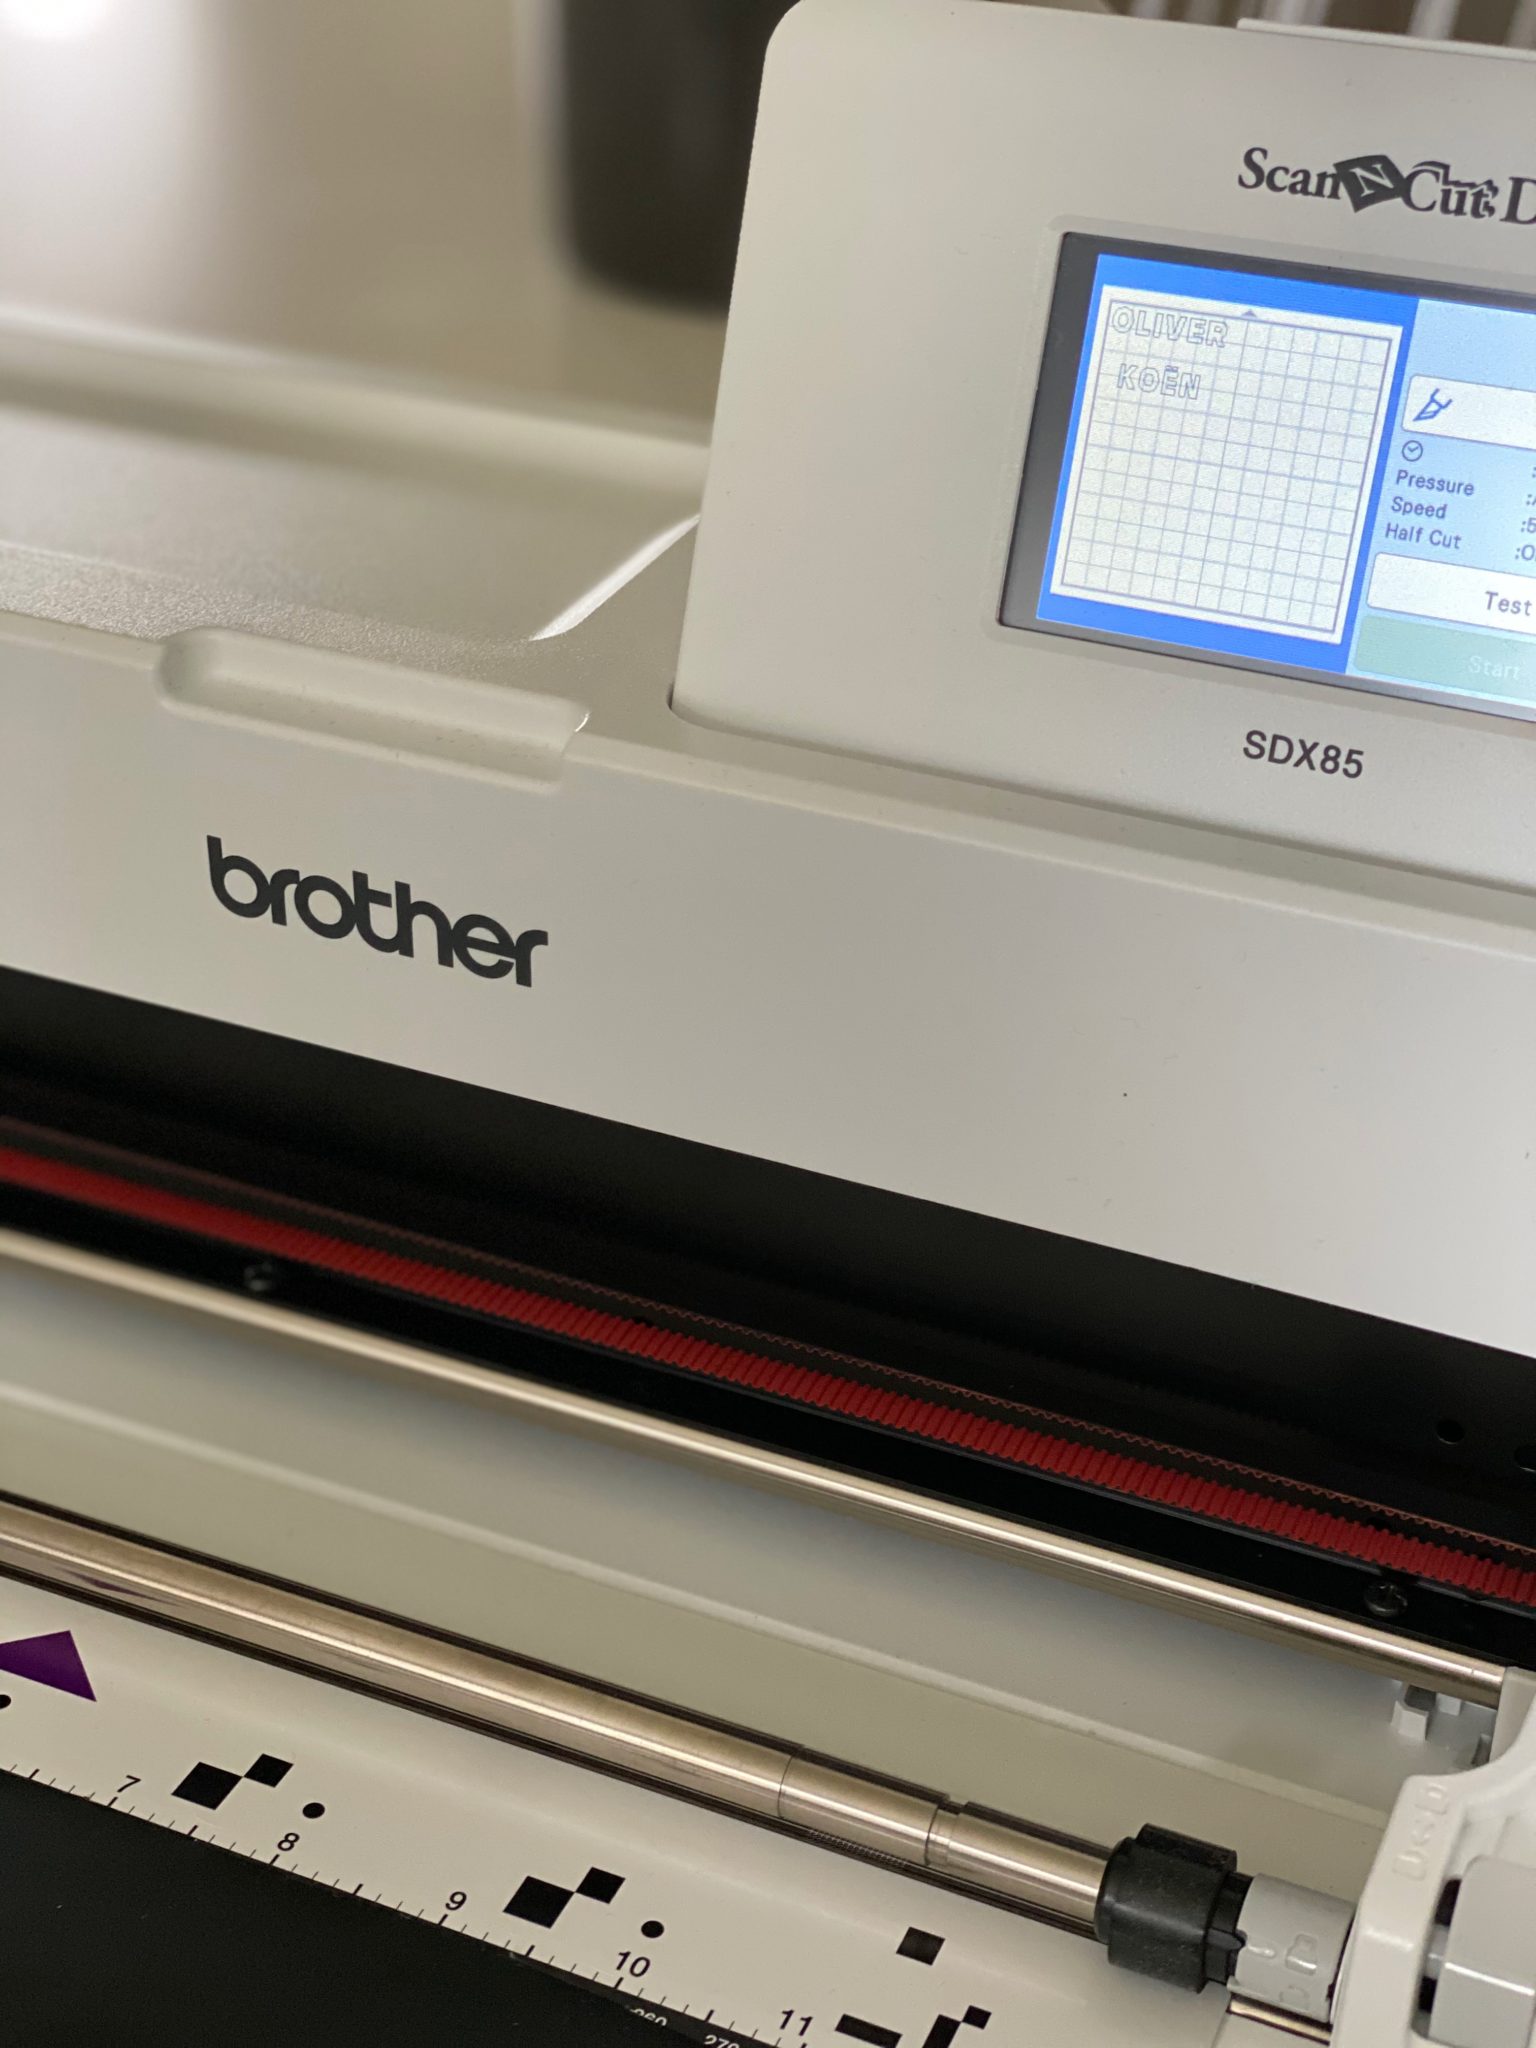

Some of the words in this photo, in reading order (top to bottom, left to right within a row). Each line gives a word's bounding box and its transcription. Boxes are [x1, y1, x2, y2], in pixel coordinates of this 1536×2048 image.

[1111, 305, 1229, 348] OLIVER
[1395, 469, 1475, 496] Pressure
[1391, 496, 1448, 519] Speed
[1385, 522, 1424, 543] Half
[1429, 529, 1462, 549] Cut
[1485, 590, 1533, 617] Test
[1468, 655, 1521, 681] Start
[1243, 729, 1365, 779] SDX85
[206, 834, 549, 988] brother
[117, 1775, 141, 1793] 7
[277, 1832, 300, 1851] 8
[445, 1891, 467, 1911] 9
[615, 1951, 651, 1977] 10
[779, 2008, 814, 2036] 11
